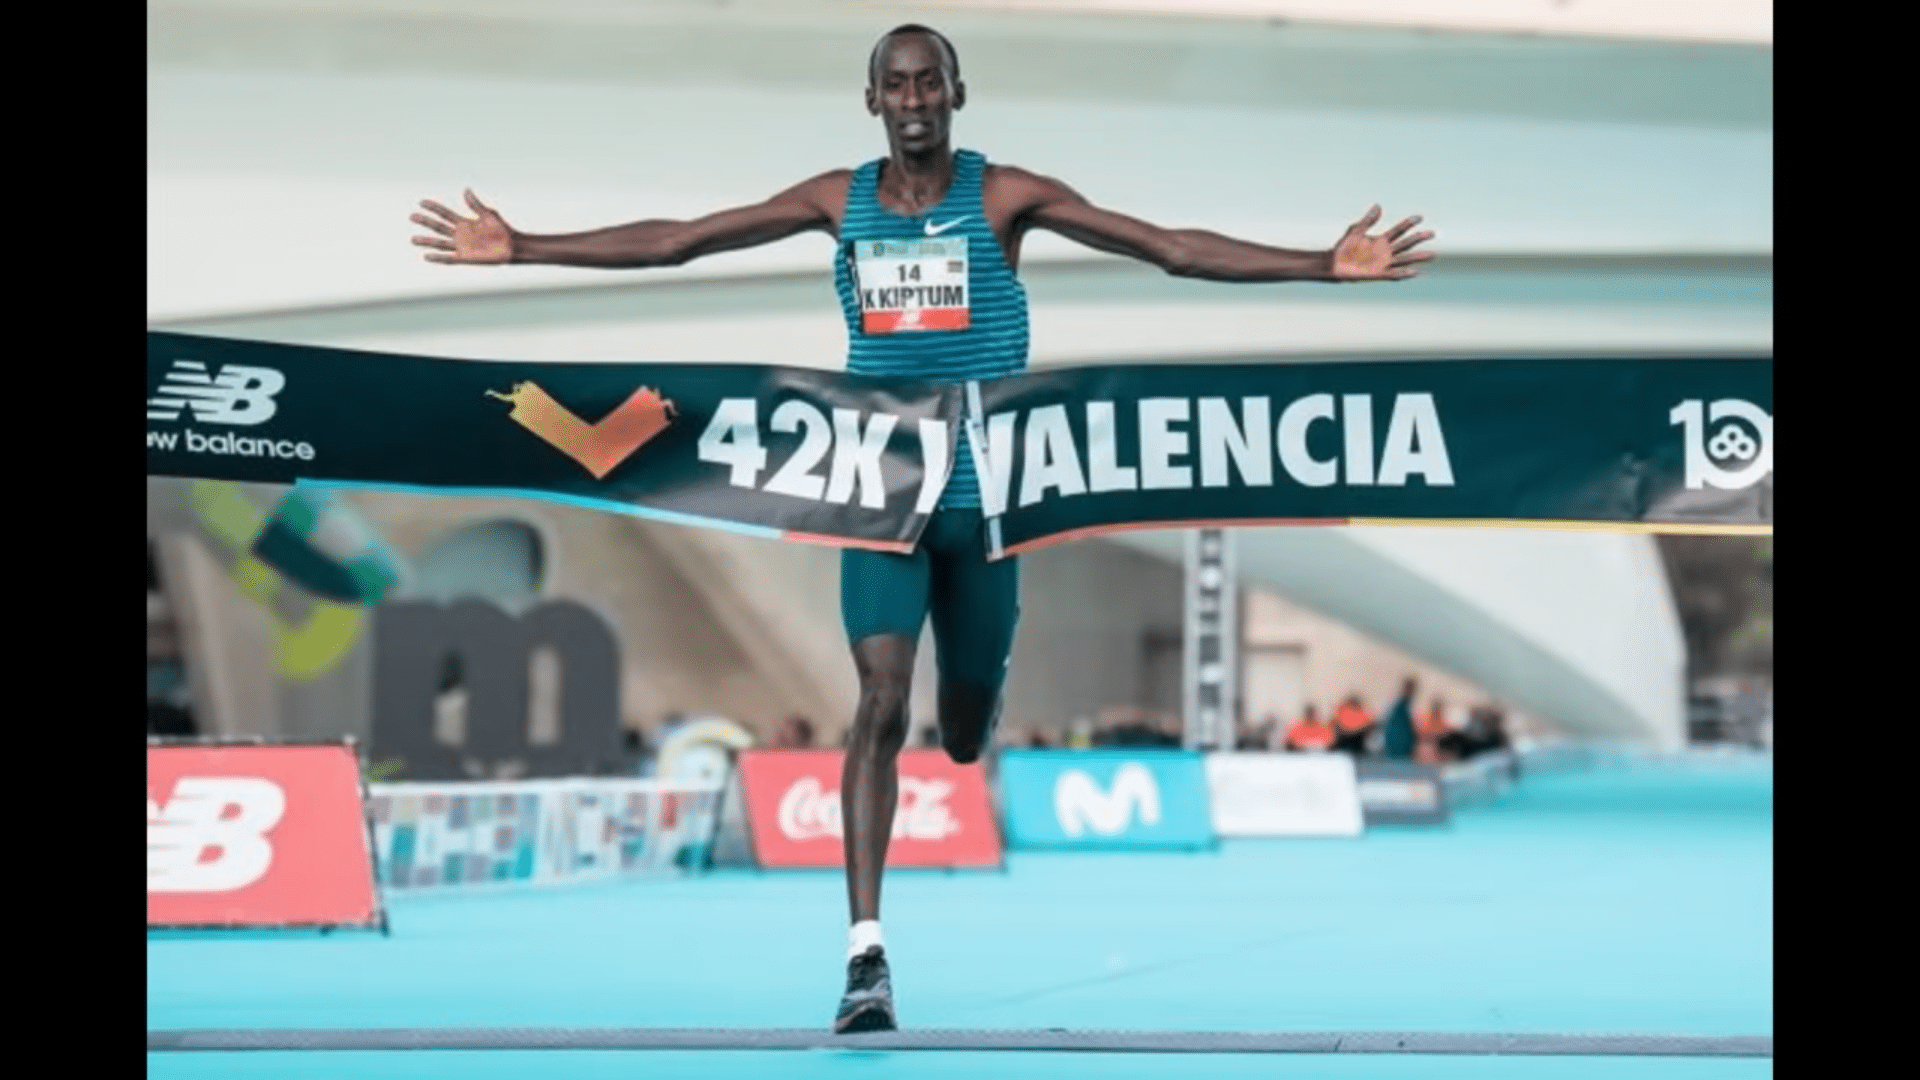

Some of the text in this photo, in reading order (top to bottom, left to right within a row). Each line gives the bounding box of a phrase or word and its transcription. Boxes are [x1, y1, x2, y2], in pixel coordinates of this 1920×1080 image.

[898, 263, 921, 283] 14
[878, 285, 964, 309] KIPTUM
[185, 428, 316, 460] balance
[698, 397, 898, 510] 42K
[965, 393, 1455, 519] VALENCIA
